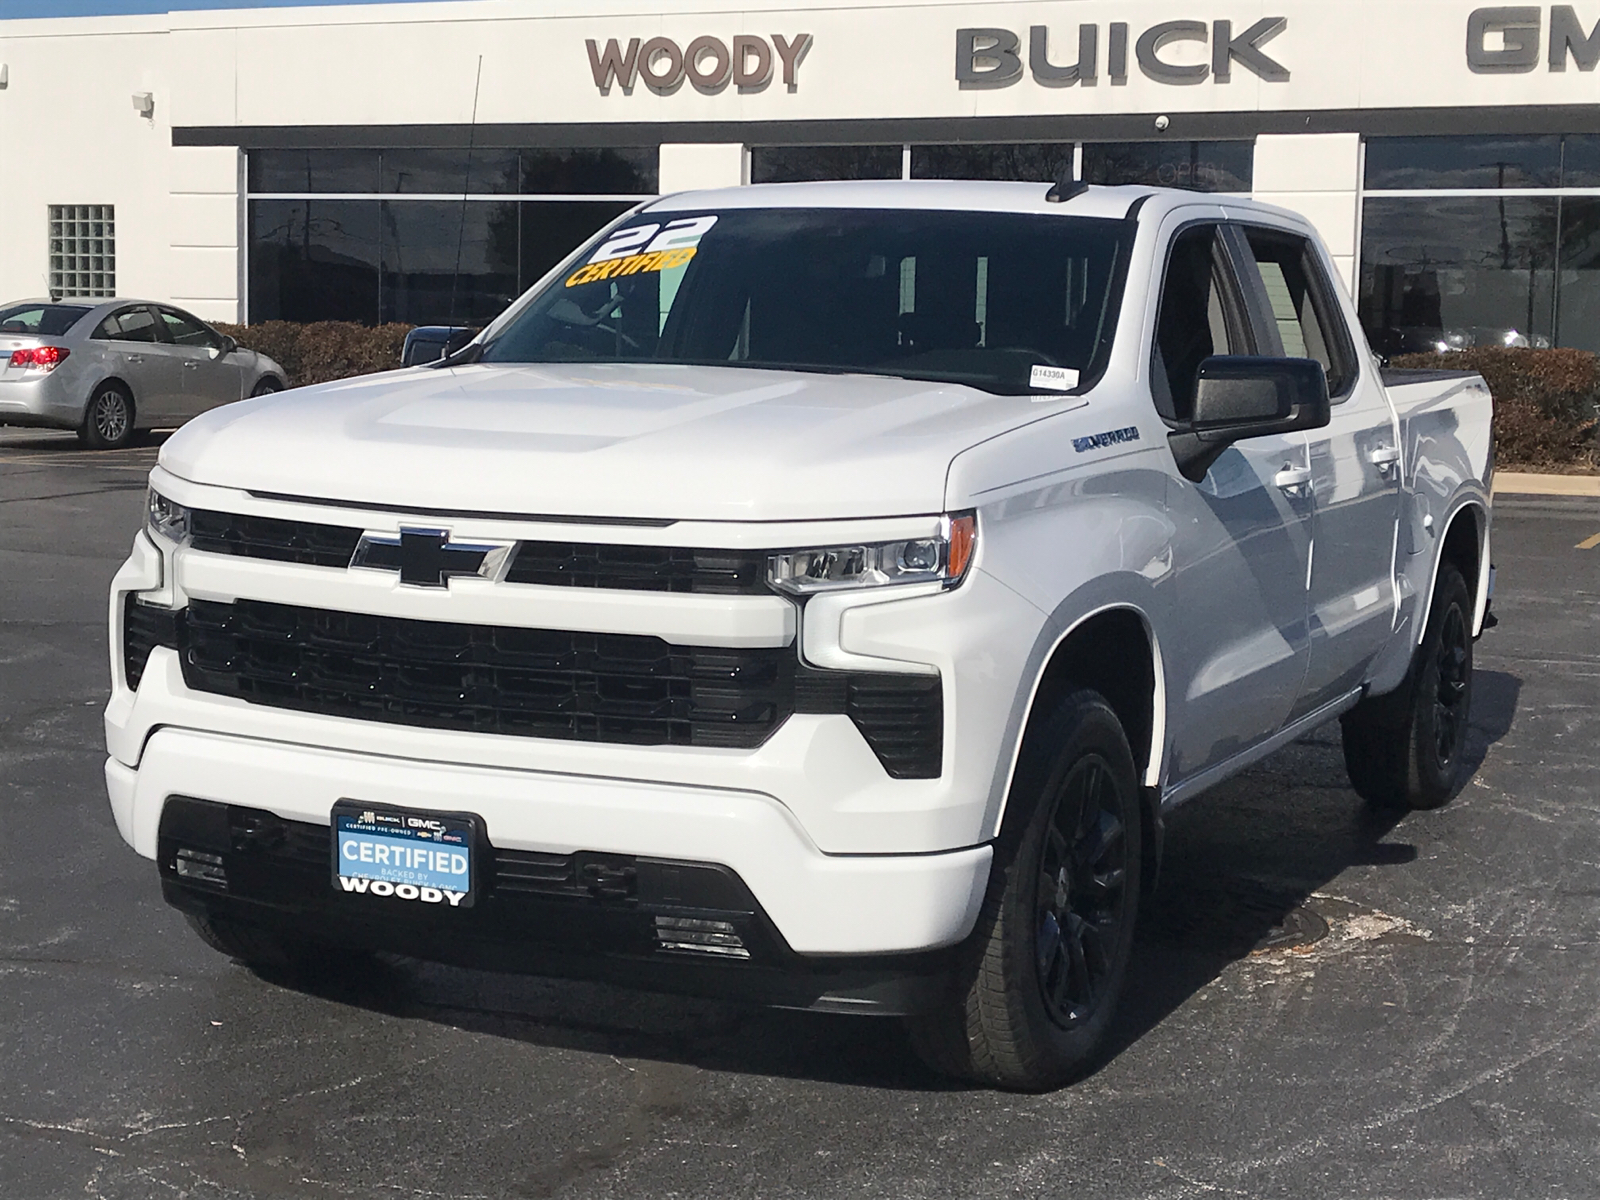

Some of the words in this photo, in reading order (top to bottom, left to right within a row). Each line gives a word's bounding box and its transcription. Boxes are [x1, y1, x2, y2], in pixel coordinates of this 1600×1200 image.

[585, 34, 812, 96] WOODY
[955, 17, 1290, 90] BUICK
[1157, 162, 1224, 185] OPEN
[587, 215, 719, 265] 22
[565, 247, 698, 288] CERTIFIED
[1032, 368, 1066, 380] G14330A
[345, 823, 376, 832] CERTIFIED
[377, 825, 412, 836] PRE-OWNED
[408, 818, 440, 830] GMC
[342, 840, 468, 875] CERTIFIED
[380, 867, 415, 879] BACKED
[417, 872, 429, 881] BY
[339, 876, 466, 906] WOODY
